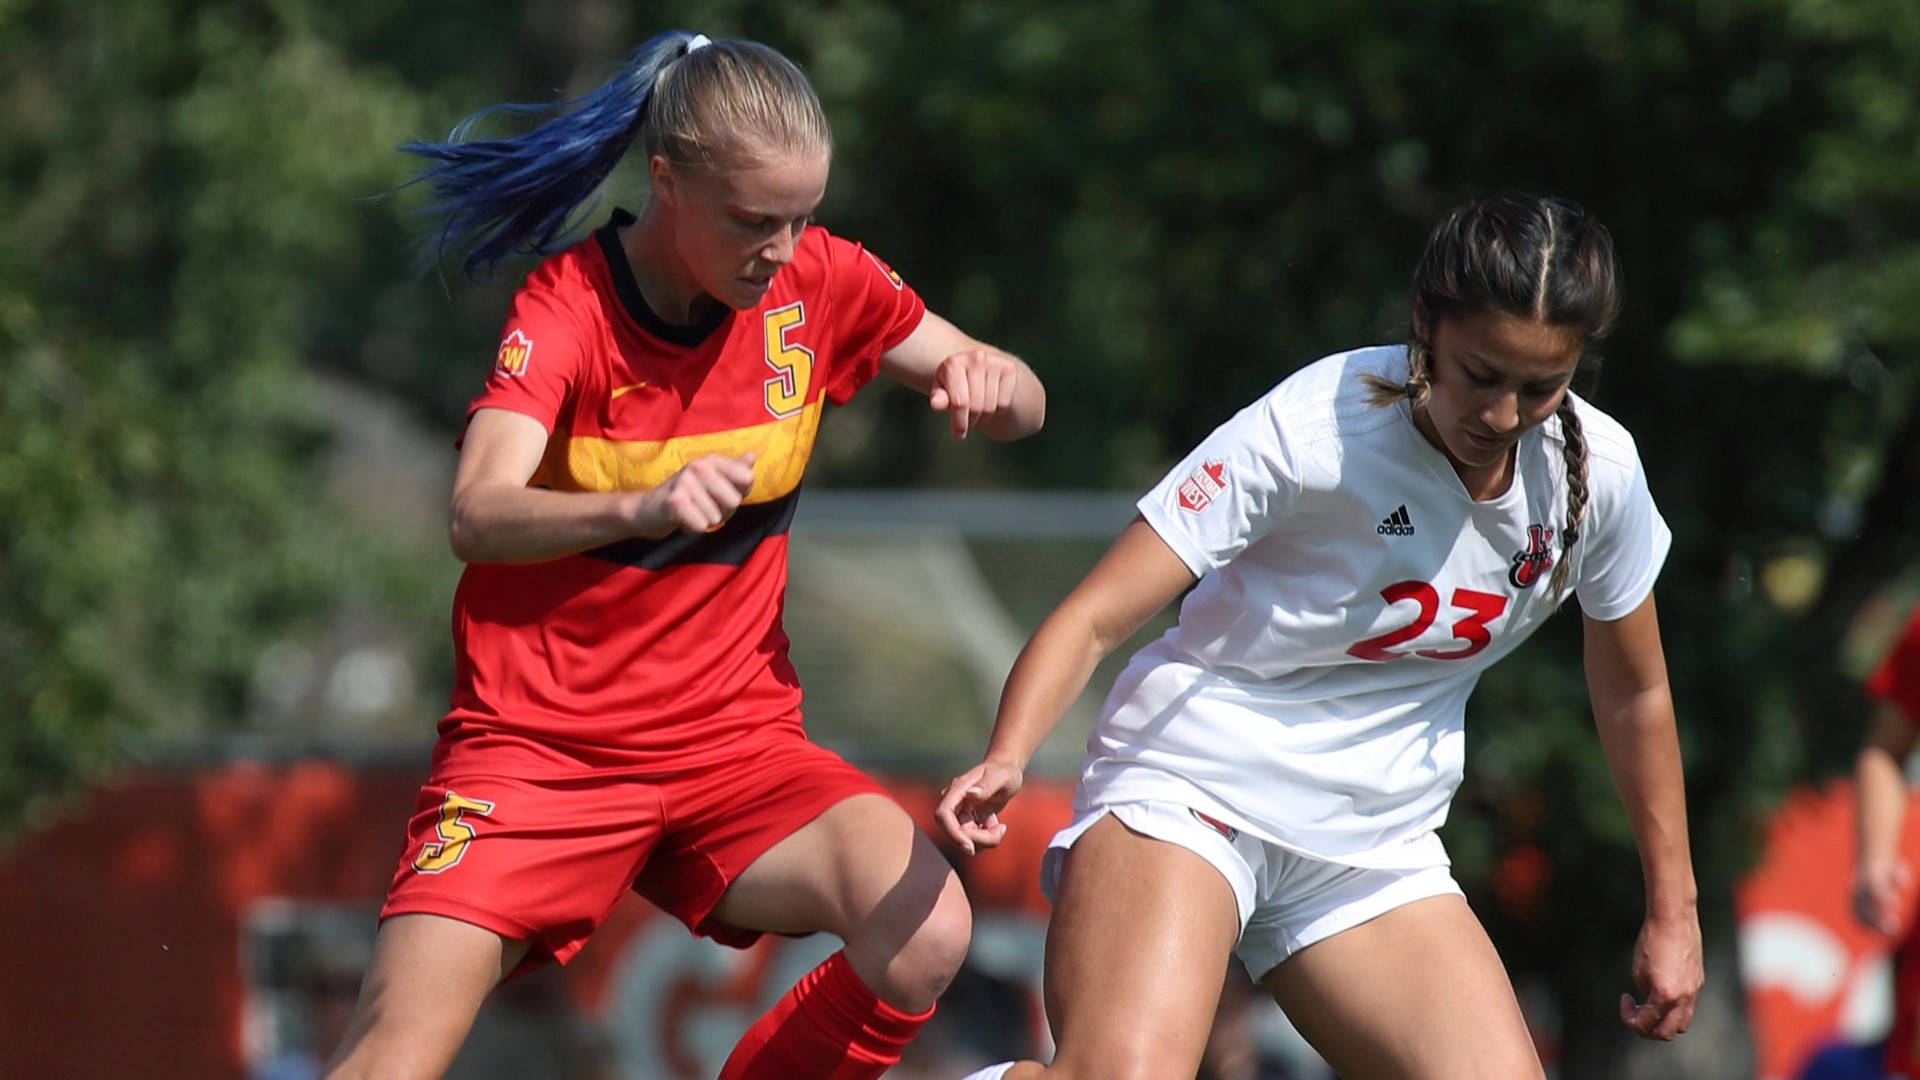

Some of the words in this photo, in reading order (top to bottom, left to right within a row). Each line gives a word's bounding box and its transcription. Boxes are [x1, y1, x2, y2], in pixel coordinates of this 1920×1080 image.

[764, 300, 814, 419] 5
[1180, 478, 1210, 510] WEST
[1376, 524, 1415, 536] adidas
[1345, 580, 1508, 662] 23
[412, 790, 495, 874] 5
